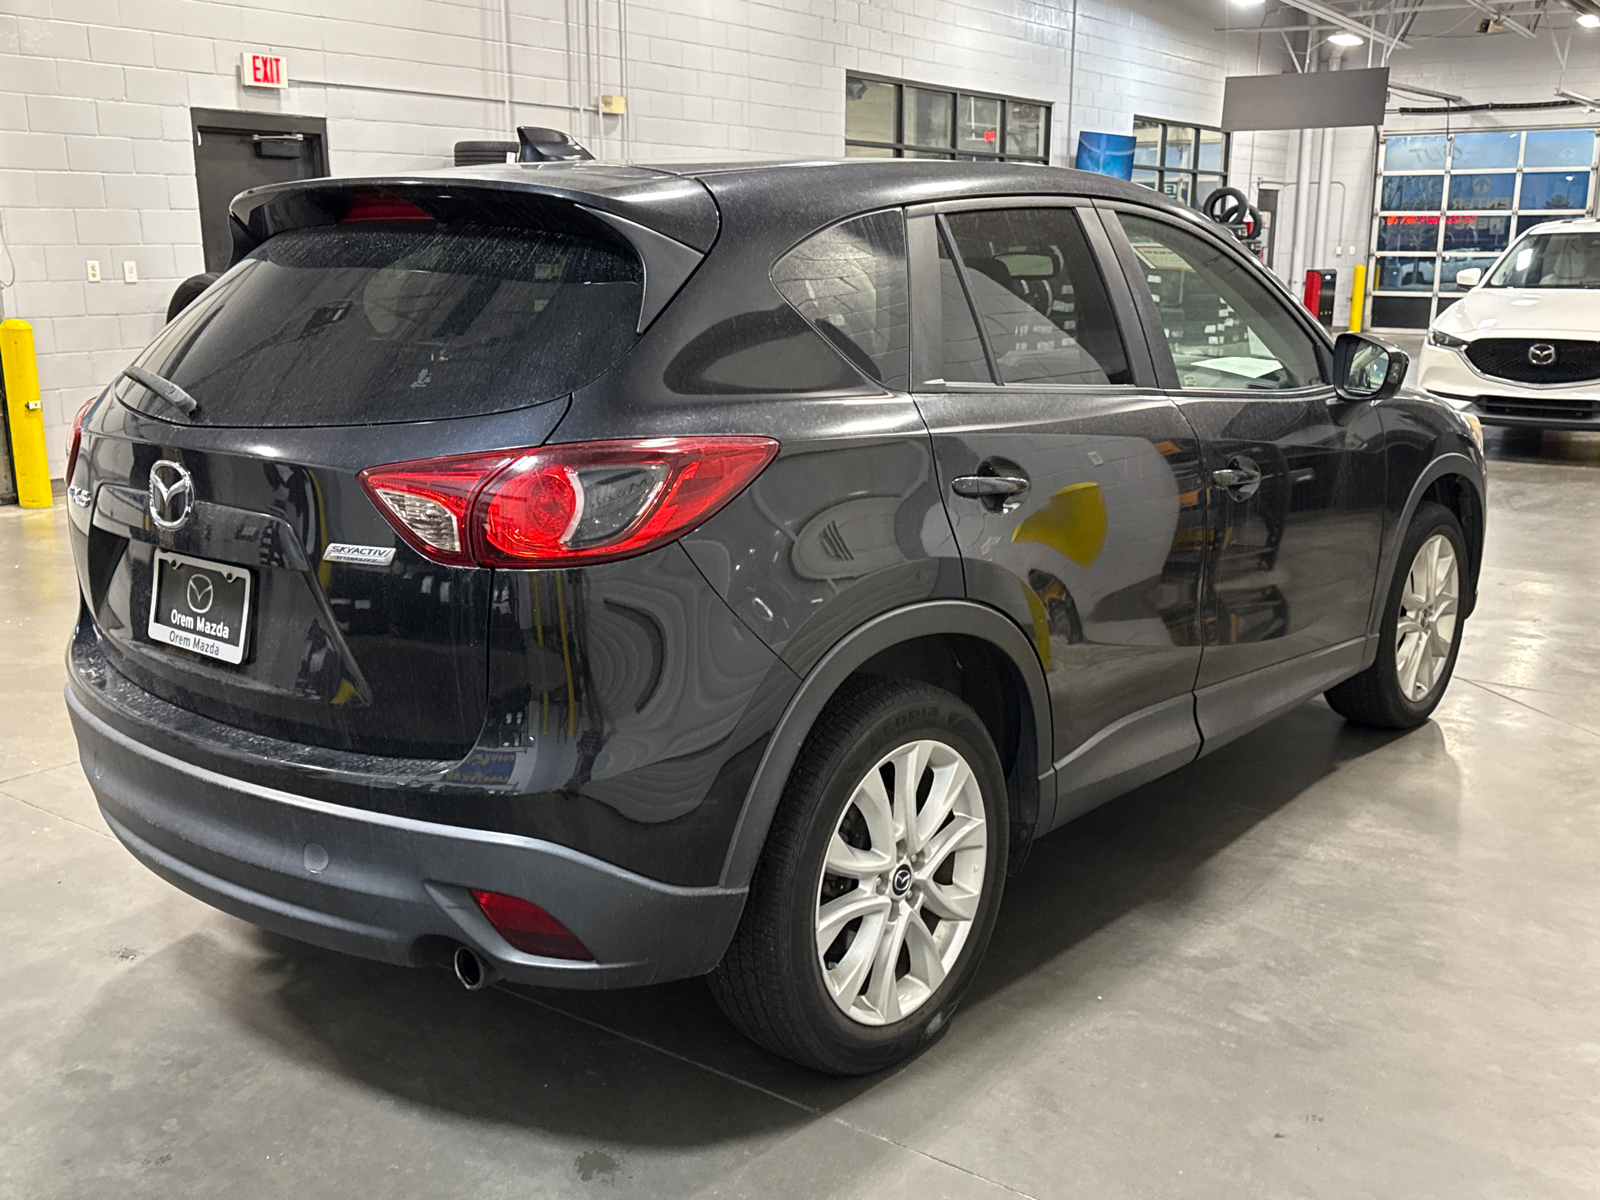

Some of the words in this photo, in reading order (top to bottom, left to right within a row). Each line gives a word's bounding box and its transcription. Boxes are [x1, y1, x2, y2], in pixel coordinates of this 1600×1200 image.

[252, 55, 281, 84] EXIT
[331, 545, 387, 556] SKYACTIV
[171, 608, 194, 629] Orem
[196, 616, 230, 639] Mazda
[169, 630, 191, 647] Orem
[192, 637, 220, 656] Mazda
